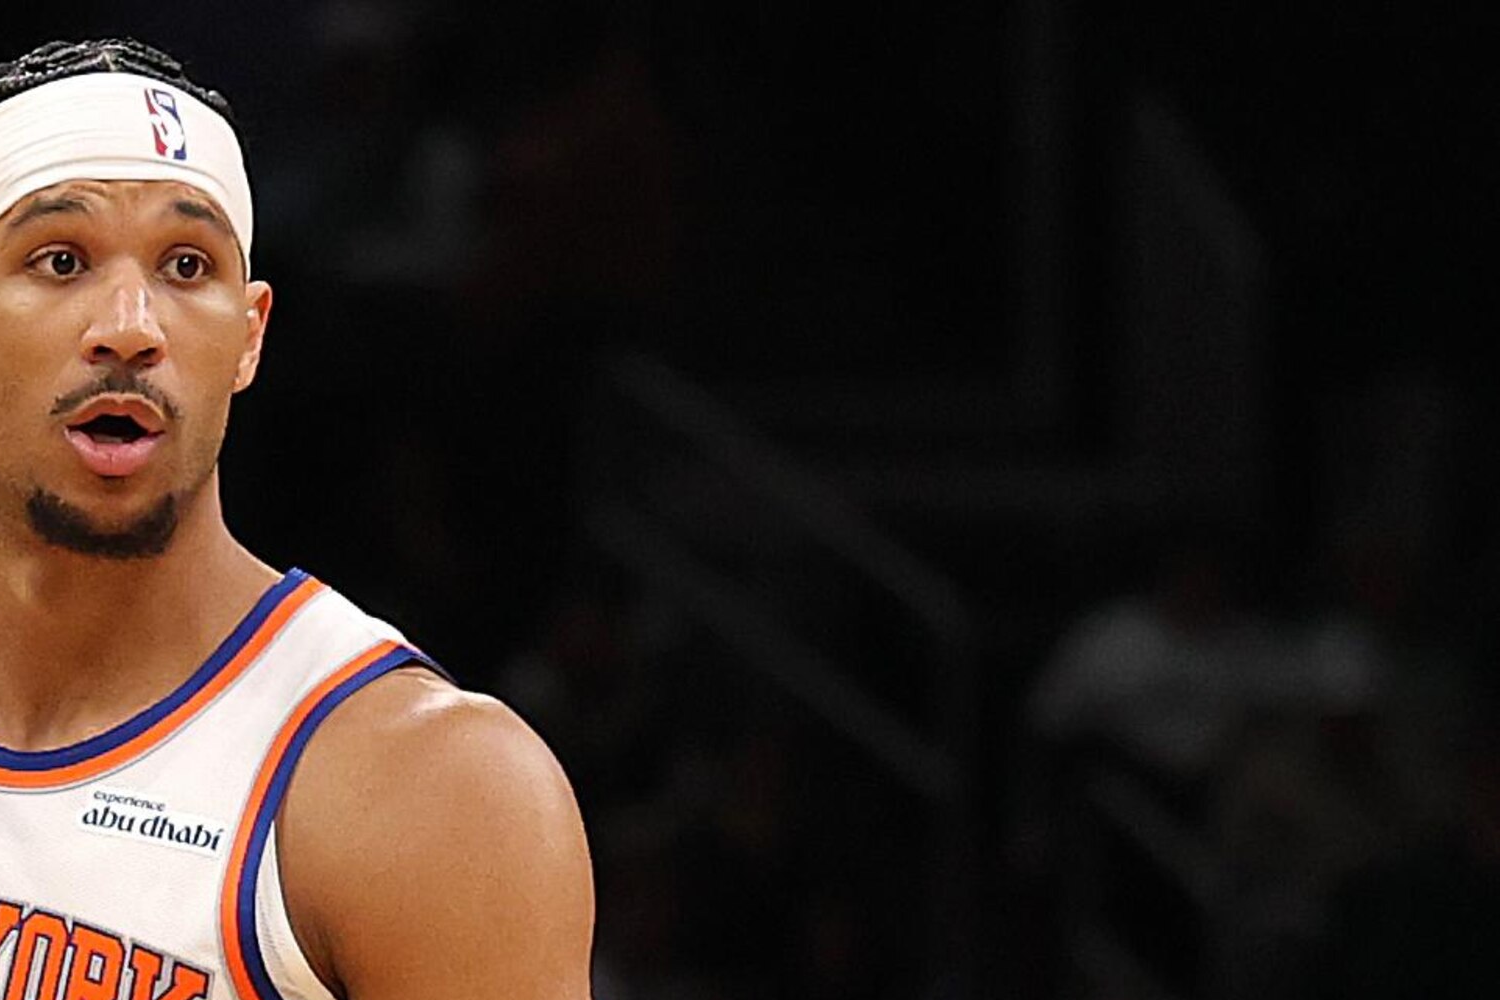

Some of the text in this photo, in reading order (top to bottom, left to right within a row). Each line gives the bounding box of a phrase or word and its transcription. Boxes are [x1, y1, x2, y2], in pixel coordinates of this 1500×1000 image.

[93, 791, 166, 812] experience
[82, 806, 224, 850] abu dhabi
